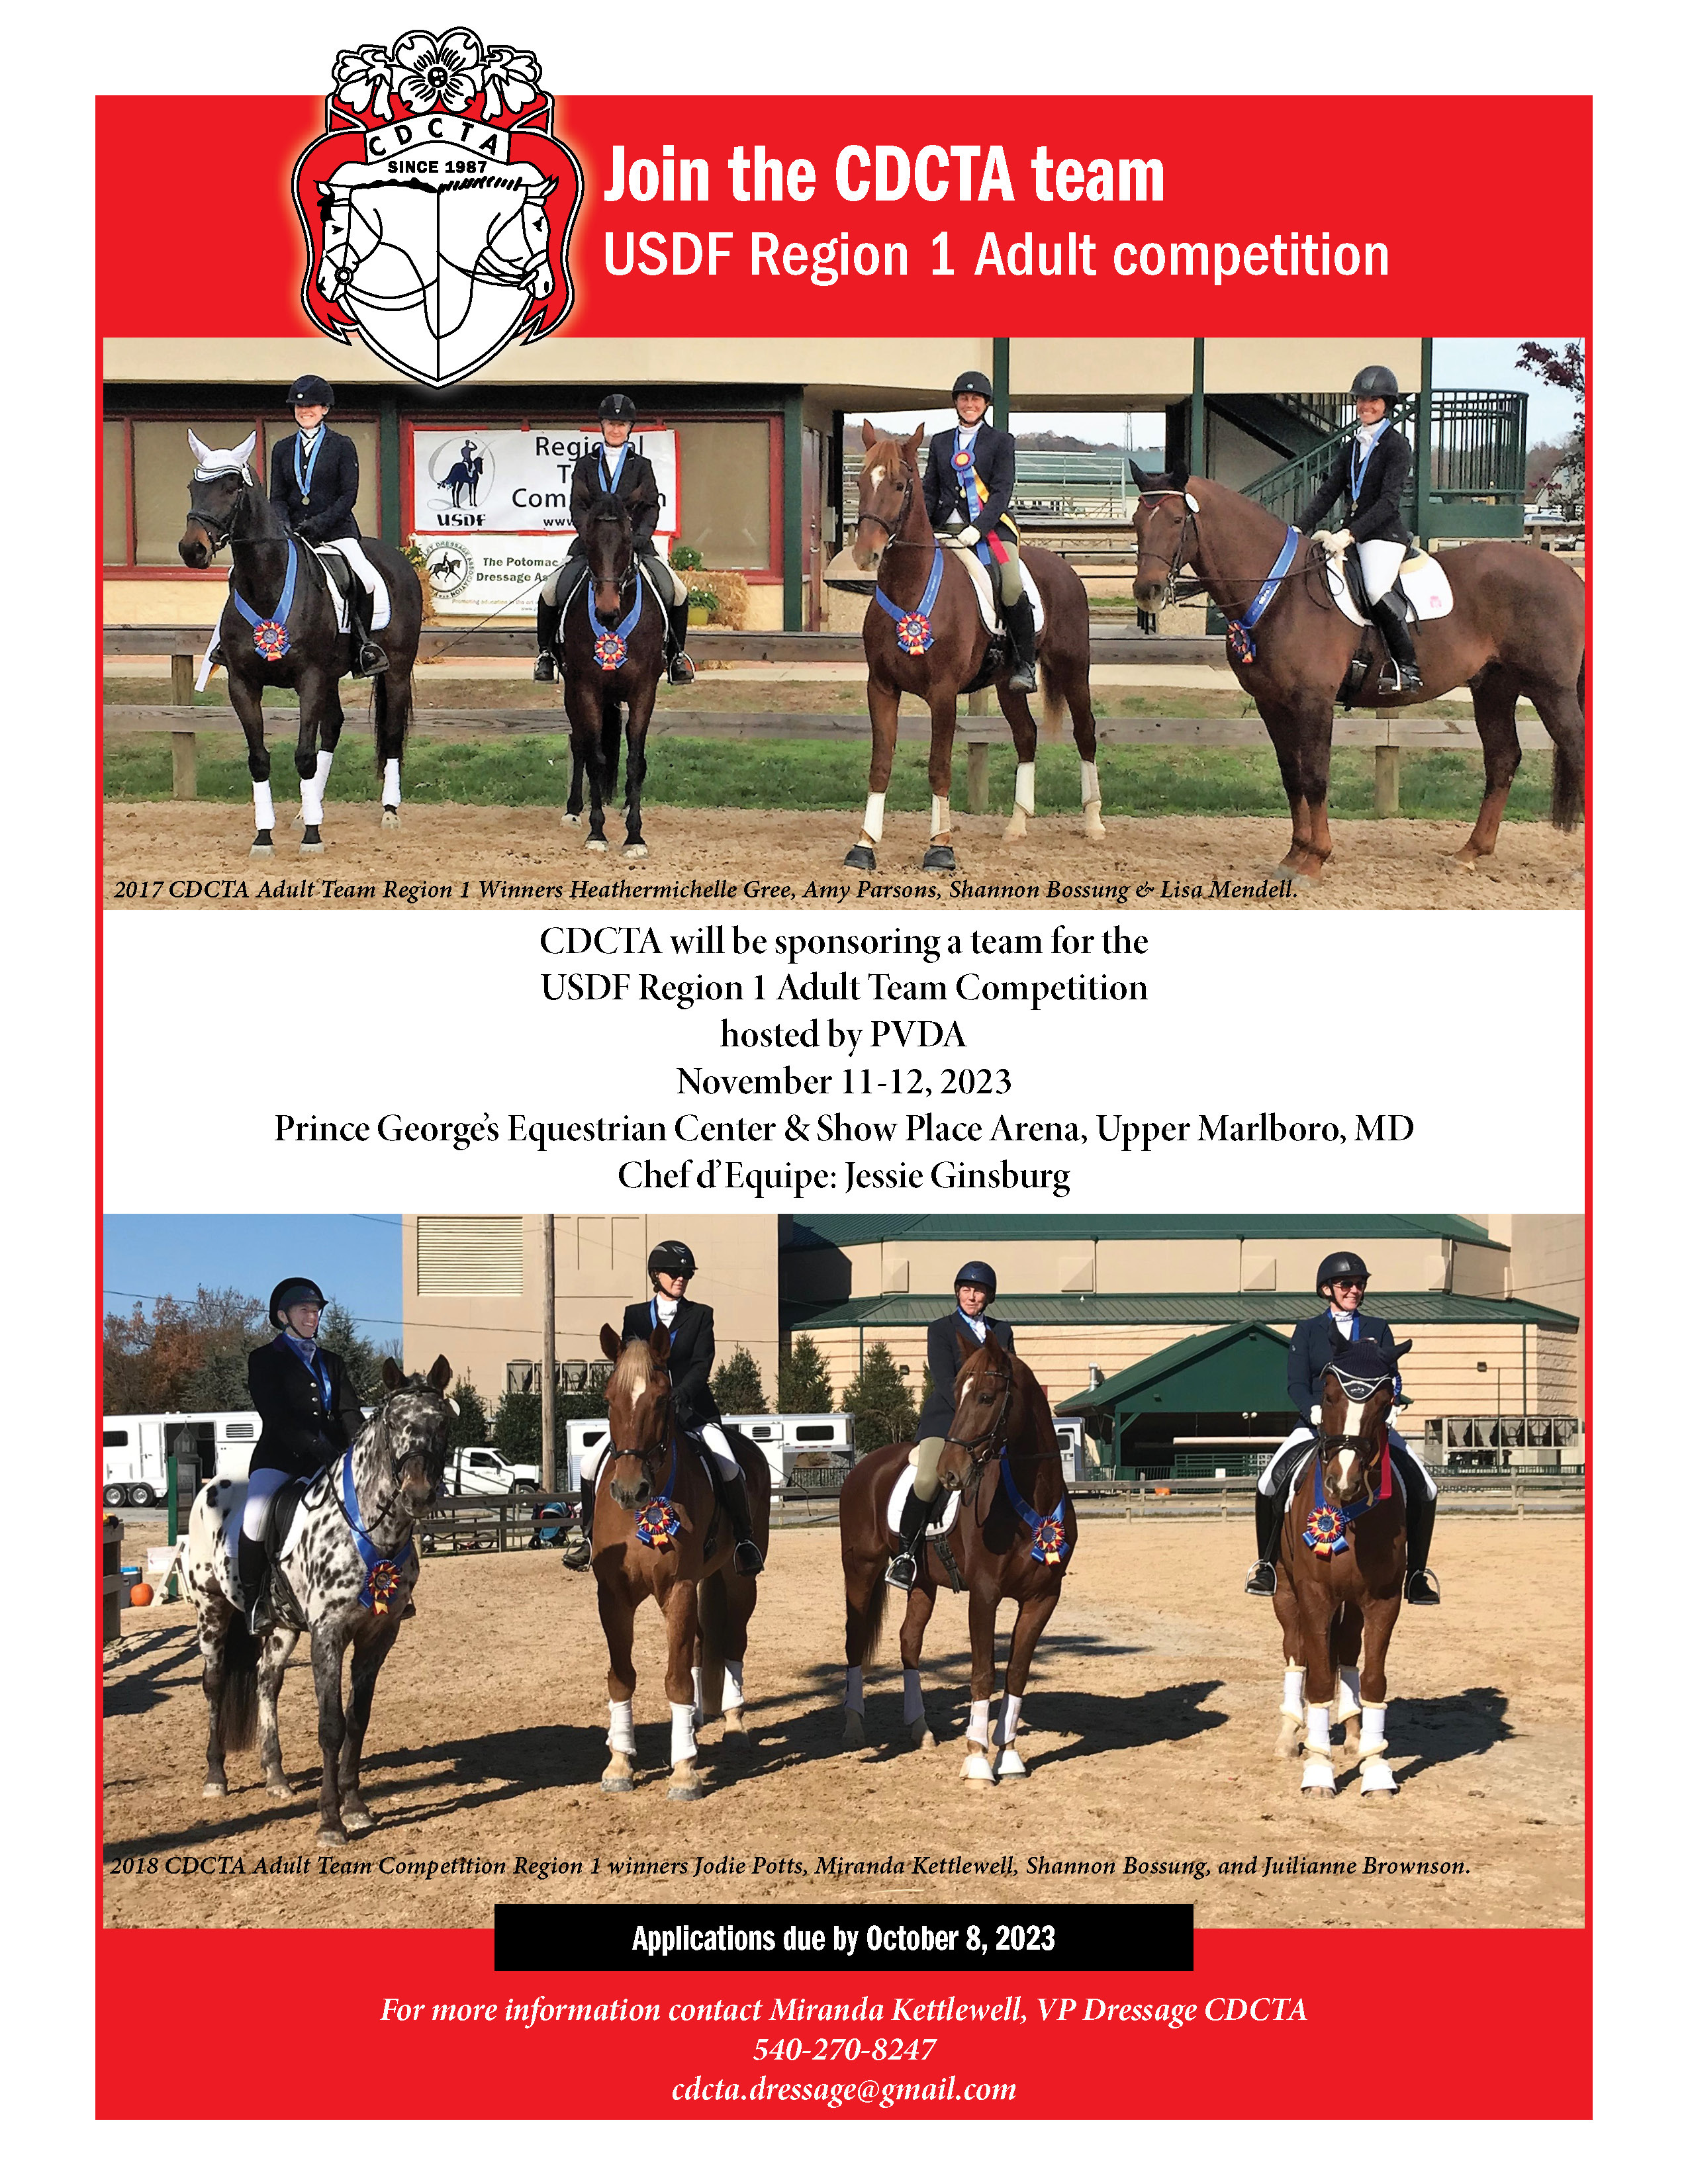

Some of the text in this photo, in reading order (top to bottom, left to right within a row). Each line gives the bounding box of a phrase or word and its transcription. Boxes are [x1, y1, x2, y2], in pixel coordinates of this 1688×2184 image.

[369, 118, 497, 156] CDCTA
[388, 161, 487, 173] SINCE 1987
[604, 145, 1163, 201] Join the CDCTA team
[606, 232, 1387, 286] USDF Region 1 Adult competition
[477, 573, 531, 583] Dressage
[483, 557, 503, 567] The
[506, 557, 559, 567] Potomac
[541, 925, 1148, 964] CDCTA will be sponsoring a team for the
[541, 972, 1148, 1010] USDF Region 1 Adult Team Competition
[720, 1019, 967, 1057] hosted by PVDA
[677, 1066, 1011, 1097] November 11-12, 2023
[275, 1113, 1413, 1151] Prince George’s Equestrian Center & Show Place Arena, Upper Marlboro, MD
[619, 1160, 1071, 1199] Chef d’Equipe: Jessie Ginsburg
[632, 1925, 1055, 1956] Applications due by October 8, 2023
[380, 1996, 1307, 2028] For more information contact Miranda Kettlewell, VP Dressage CDCTA
[753, 2038, 937, 2060] 540-270-8247
[673, 2075, 1015, 2108] cdcta.dressage@gmail.com
